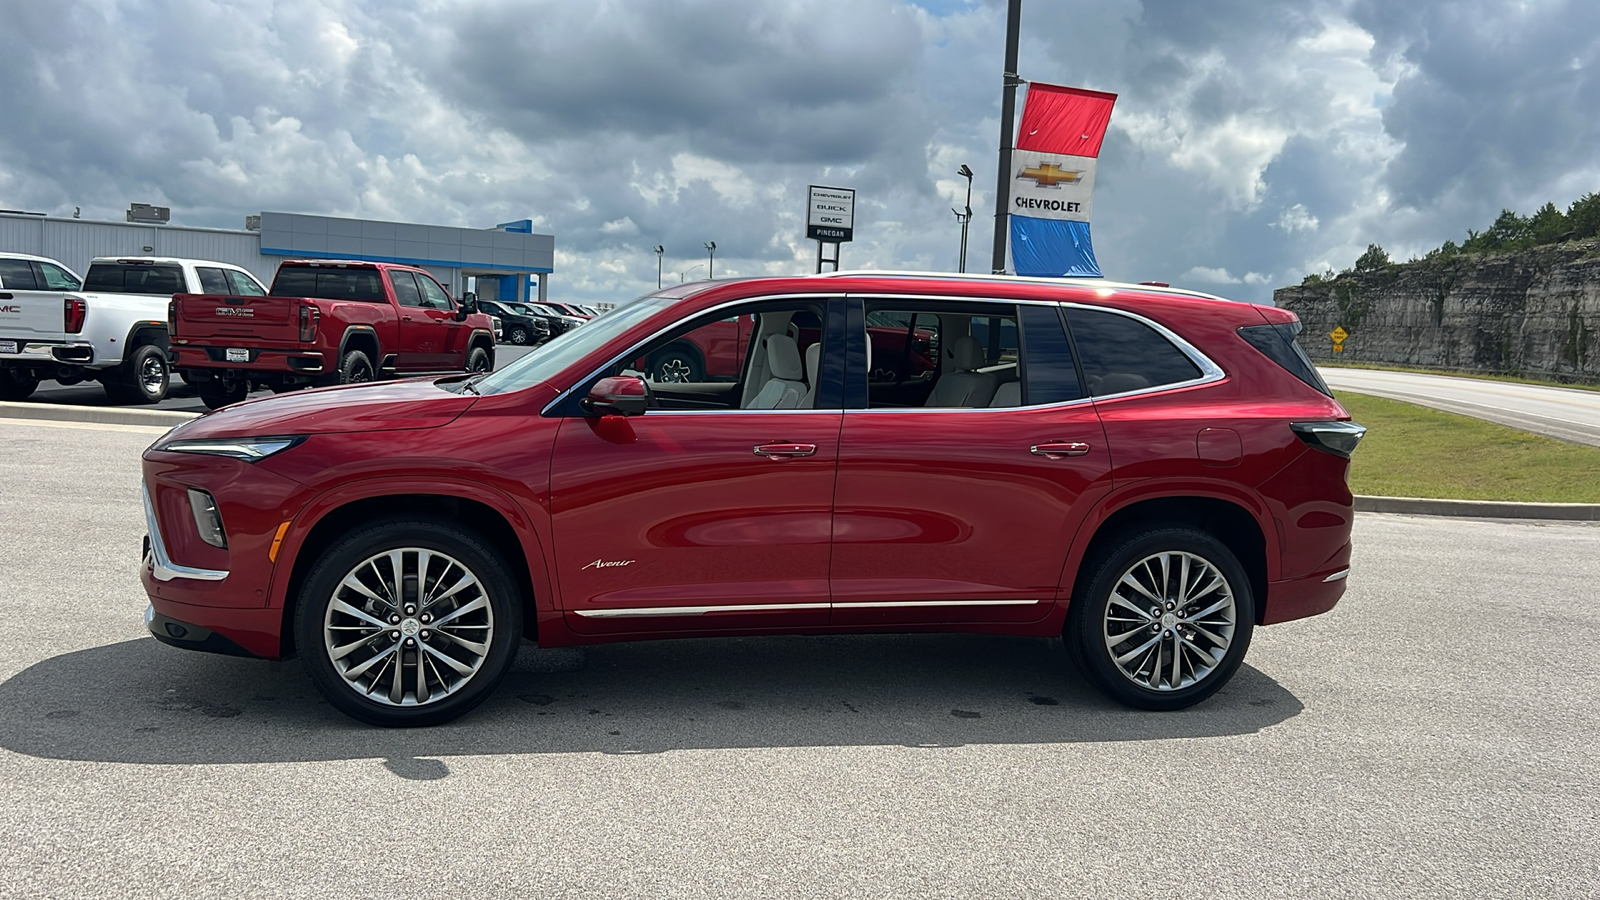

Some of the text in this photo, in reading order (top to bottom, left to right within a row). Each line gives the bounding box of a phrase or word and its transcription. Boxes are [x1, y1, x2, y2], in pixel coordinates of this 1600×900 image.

[1015, 196, 1081, 213] CHEVROLET
[816, 229, 844, 237] PINEGAR
[0, 305, 21, 313] MC
[215, 307, 254, 317] GMC
[581, 558, 636, 571] Avenir
